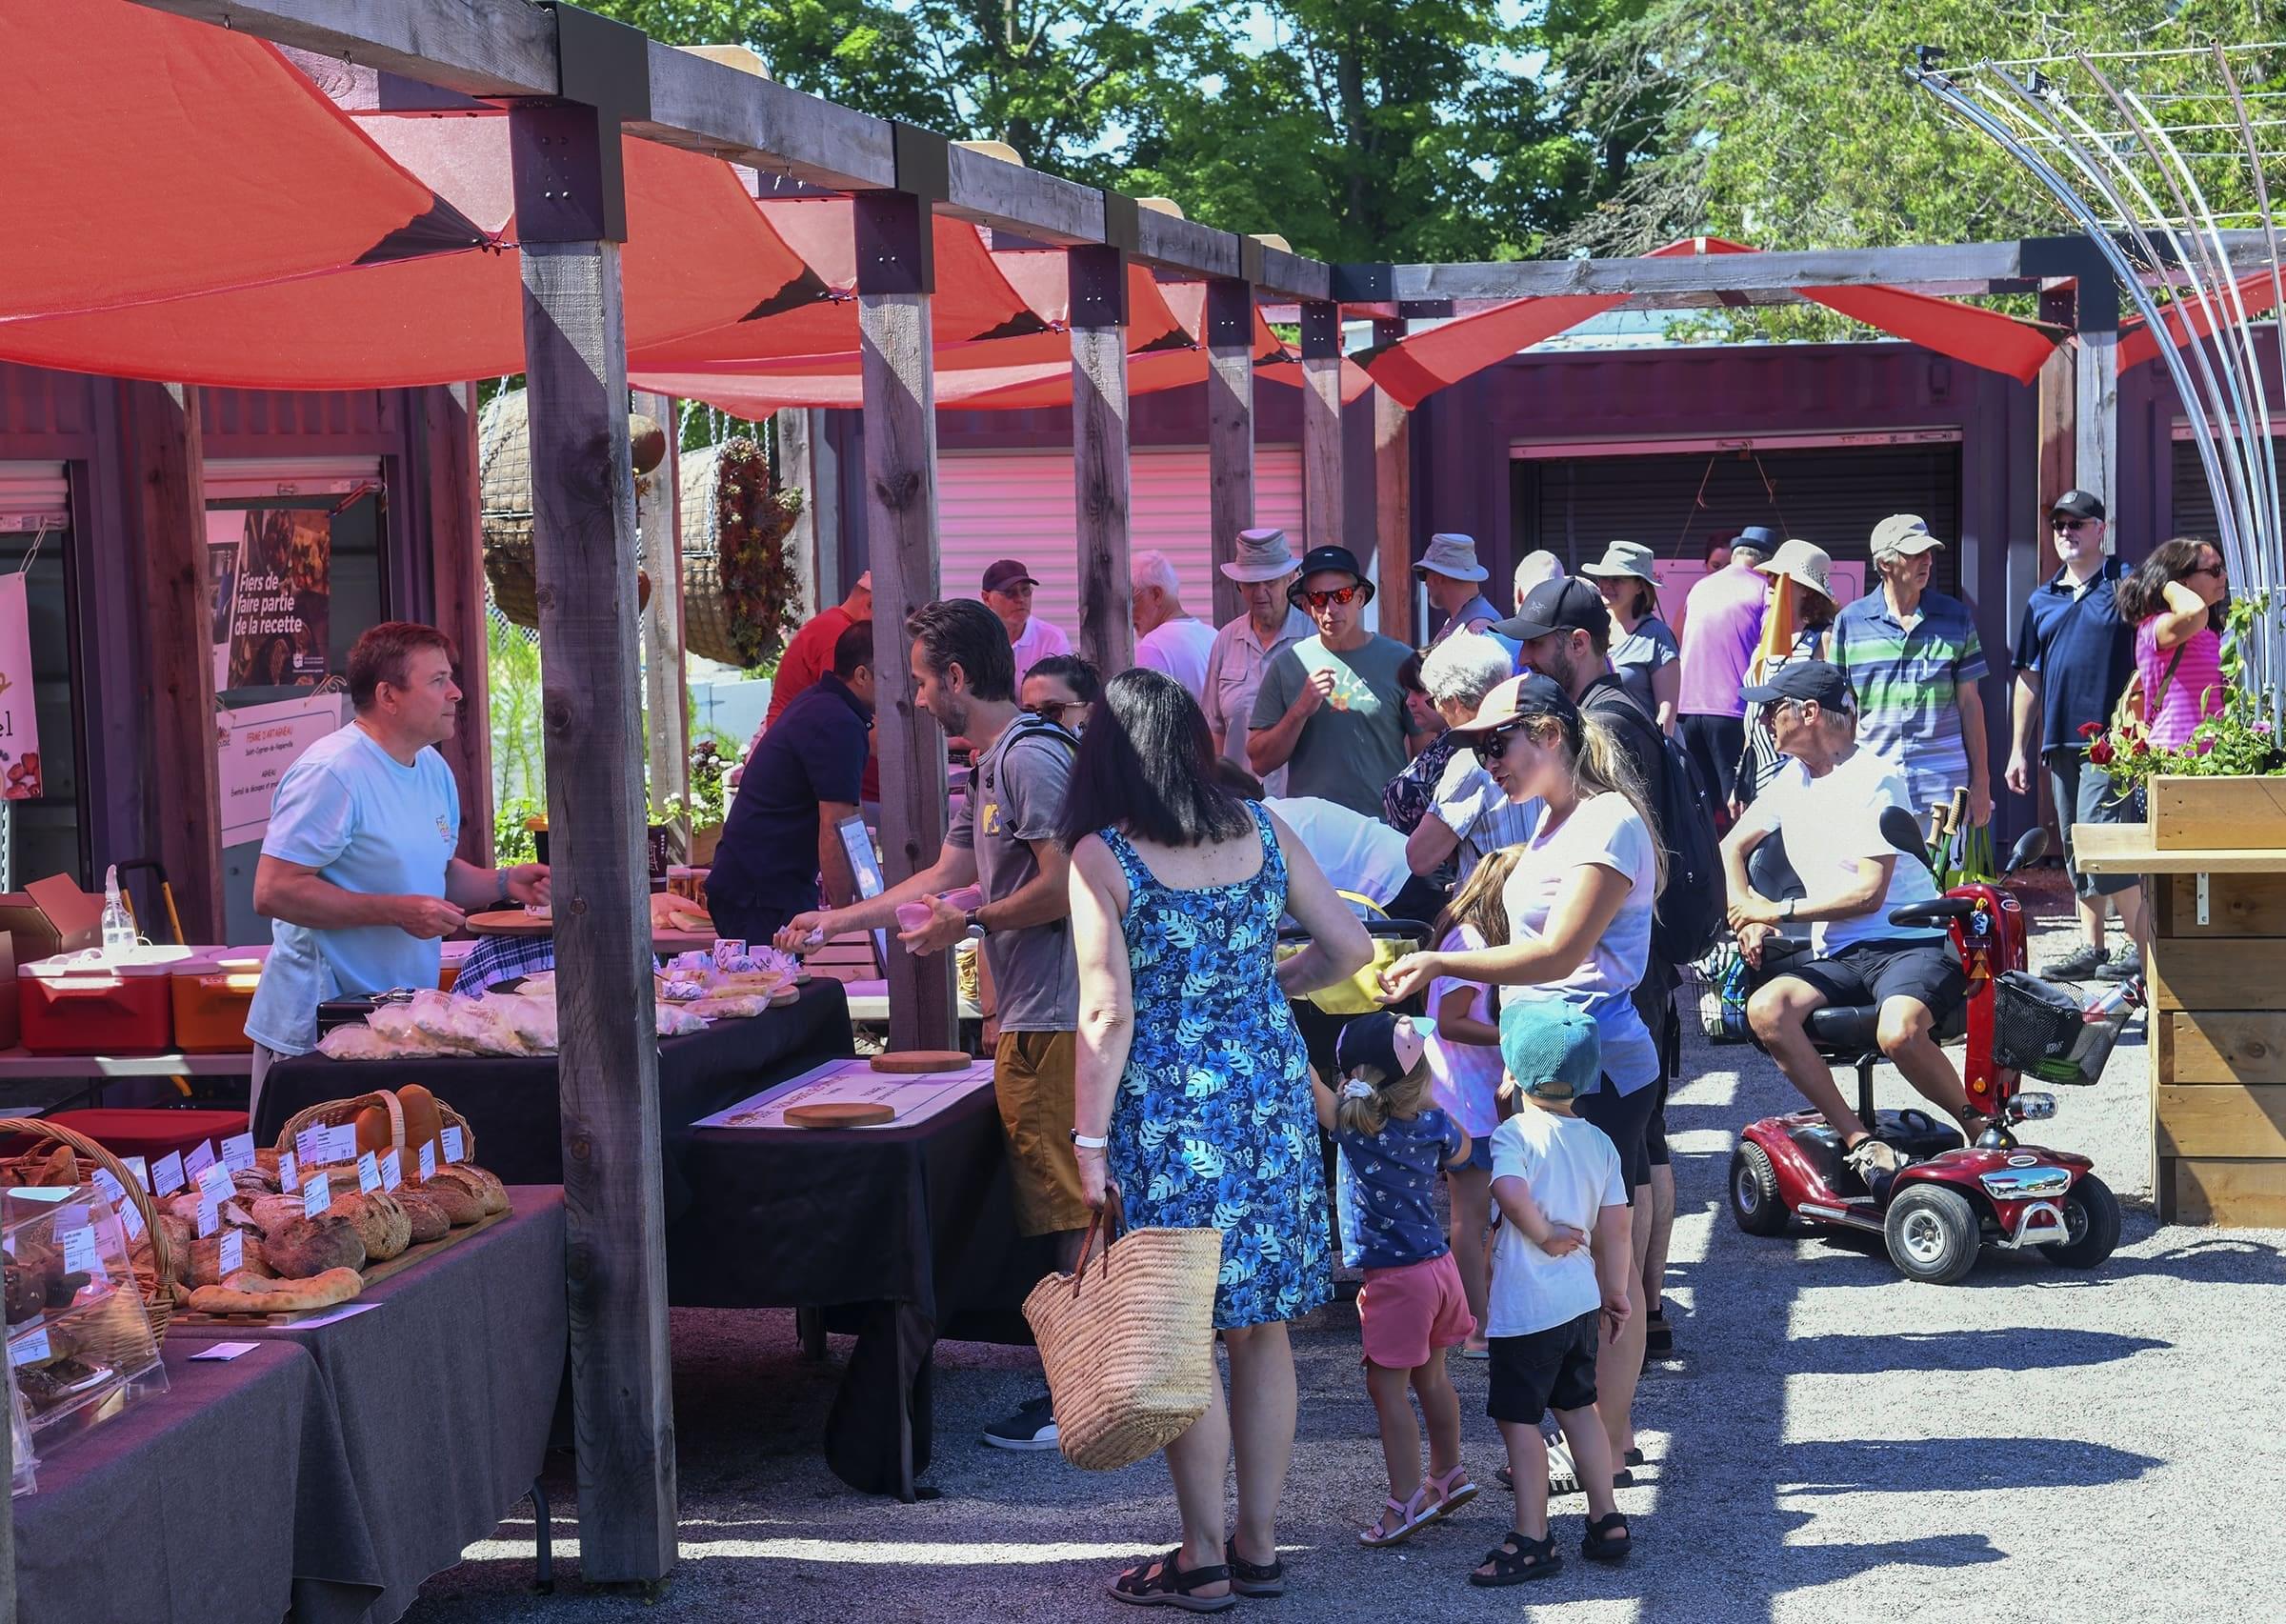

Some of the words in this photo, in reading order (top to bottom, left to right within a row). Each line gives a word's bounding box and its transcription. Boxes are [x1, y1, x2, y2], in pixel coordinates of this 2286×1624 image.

[239, 571, 264, 592] Fiers
[265, 571, 279, 591] de
[237, 592, 259, 613] faire
[260, 591, 295, 616] partie
[234, 616, 247, 635] de
[249, 615, 257, 634] la
[260, 614, 303, 634] recette
[1331, 669, 1375, 702] LEY
